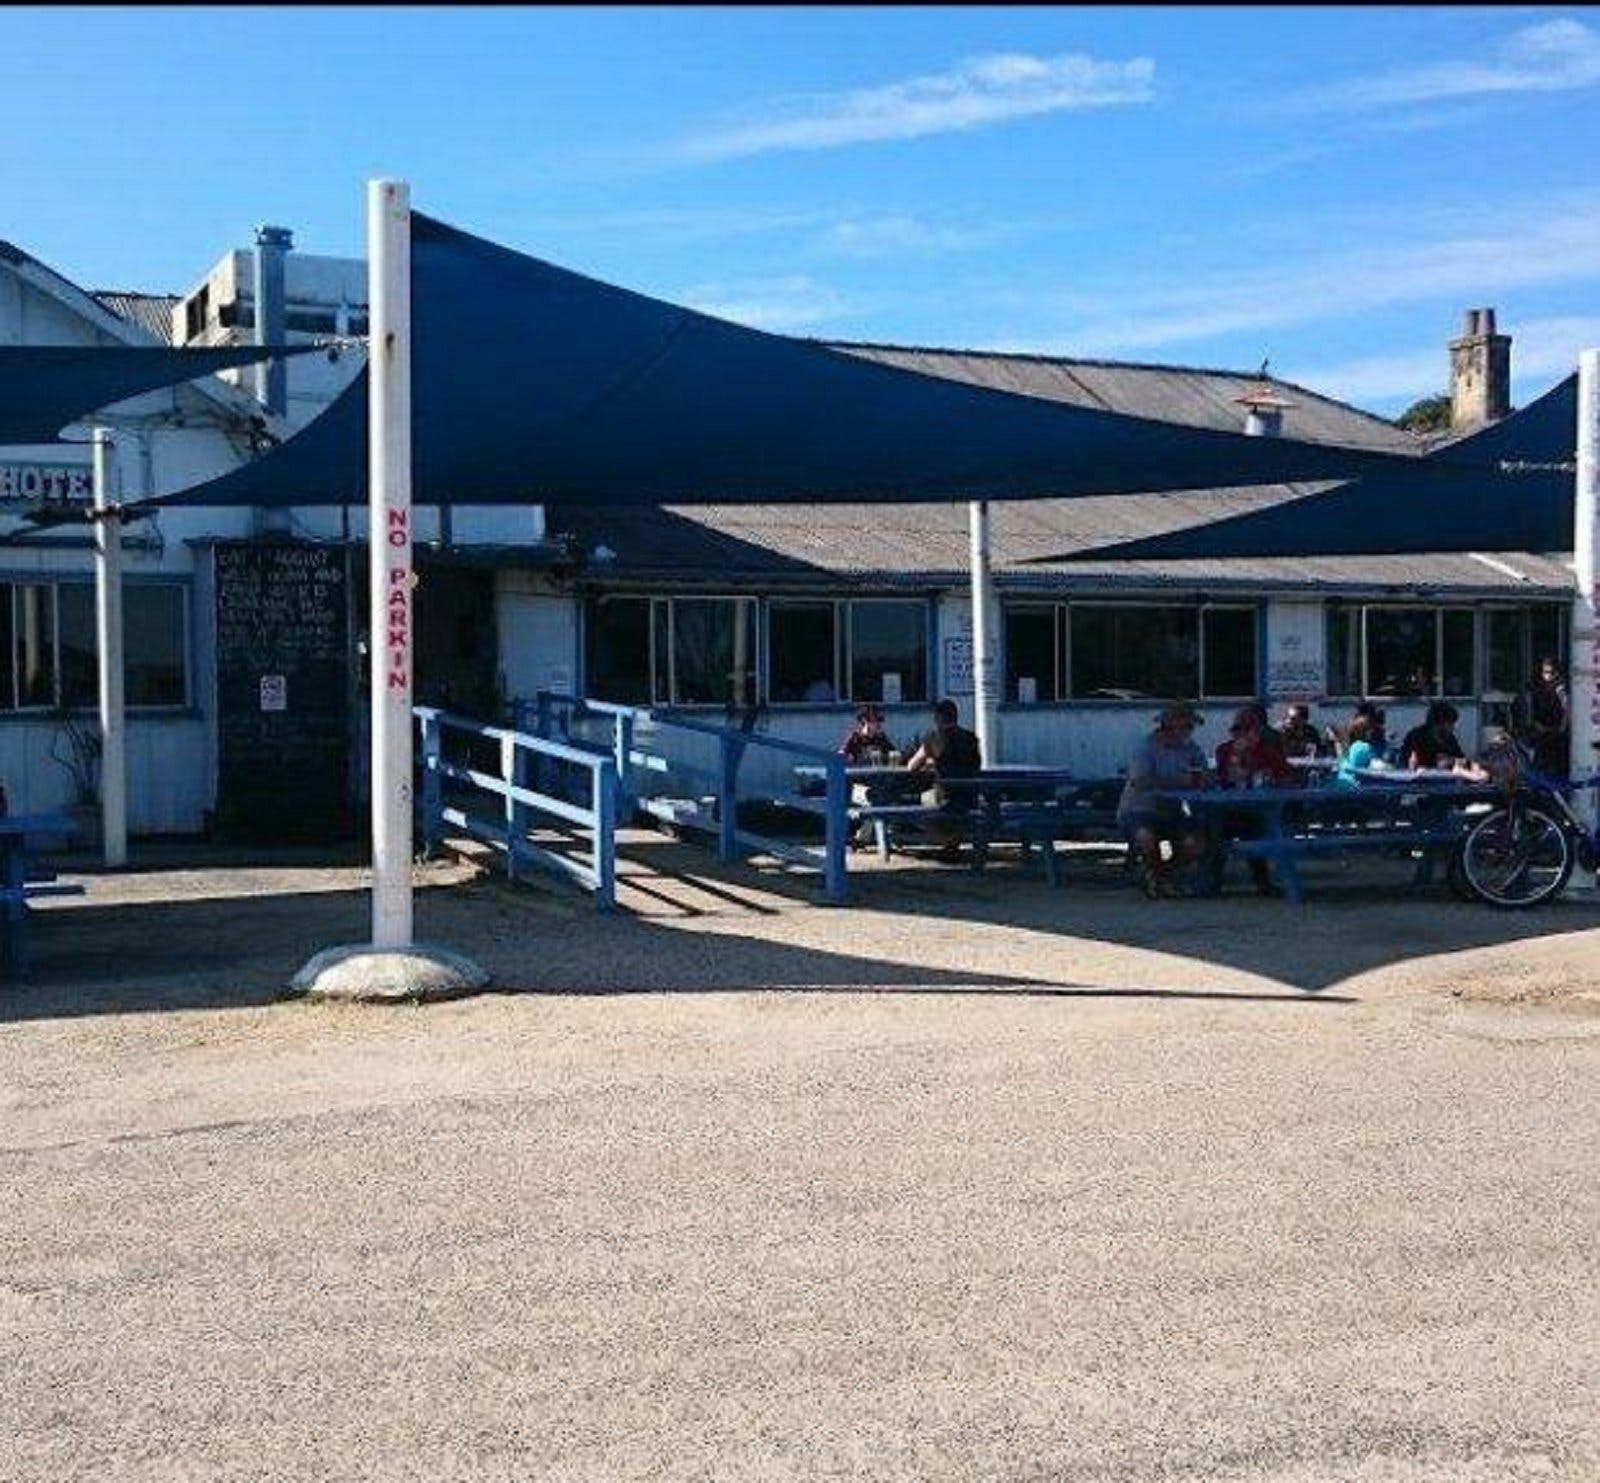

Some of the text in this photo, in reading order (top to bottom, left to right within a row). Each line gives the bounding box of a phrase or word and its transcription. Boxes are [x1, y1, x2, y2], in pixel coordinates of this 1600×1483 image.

[0, 467, 94, 500] HOTE
[388, 509, 406, 687] NO PARKIN
